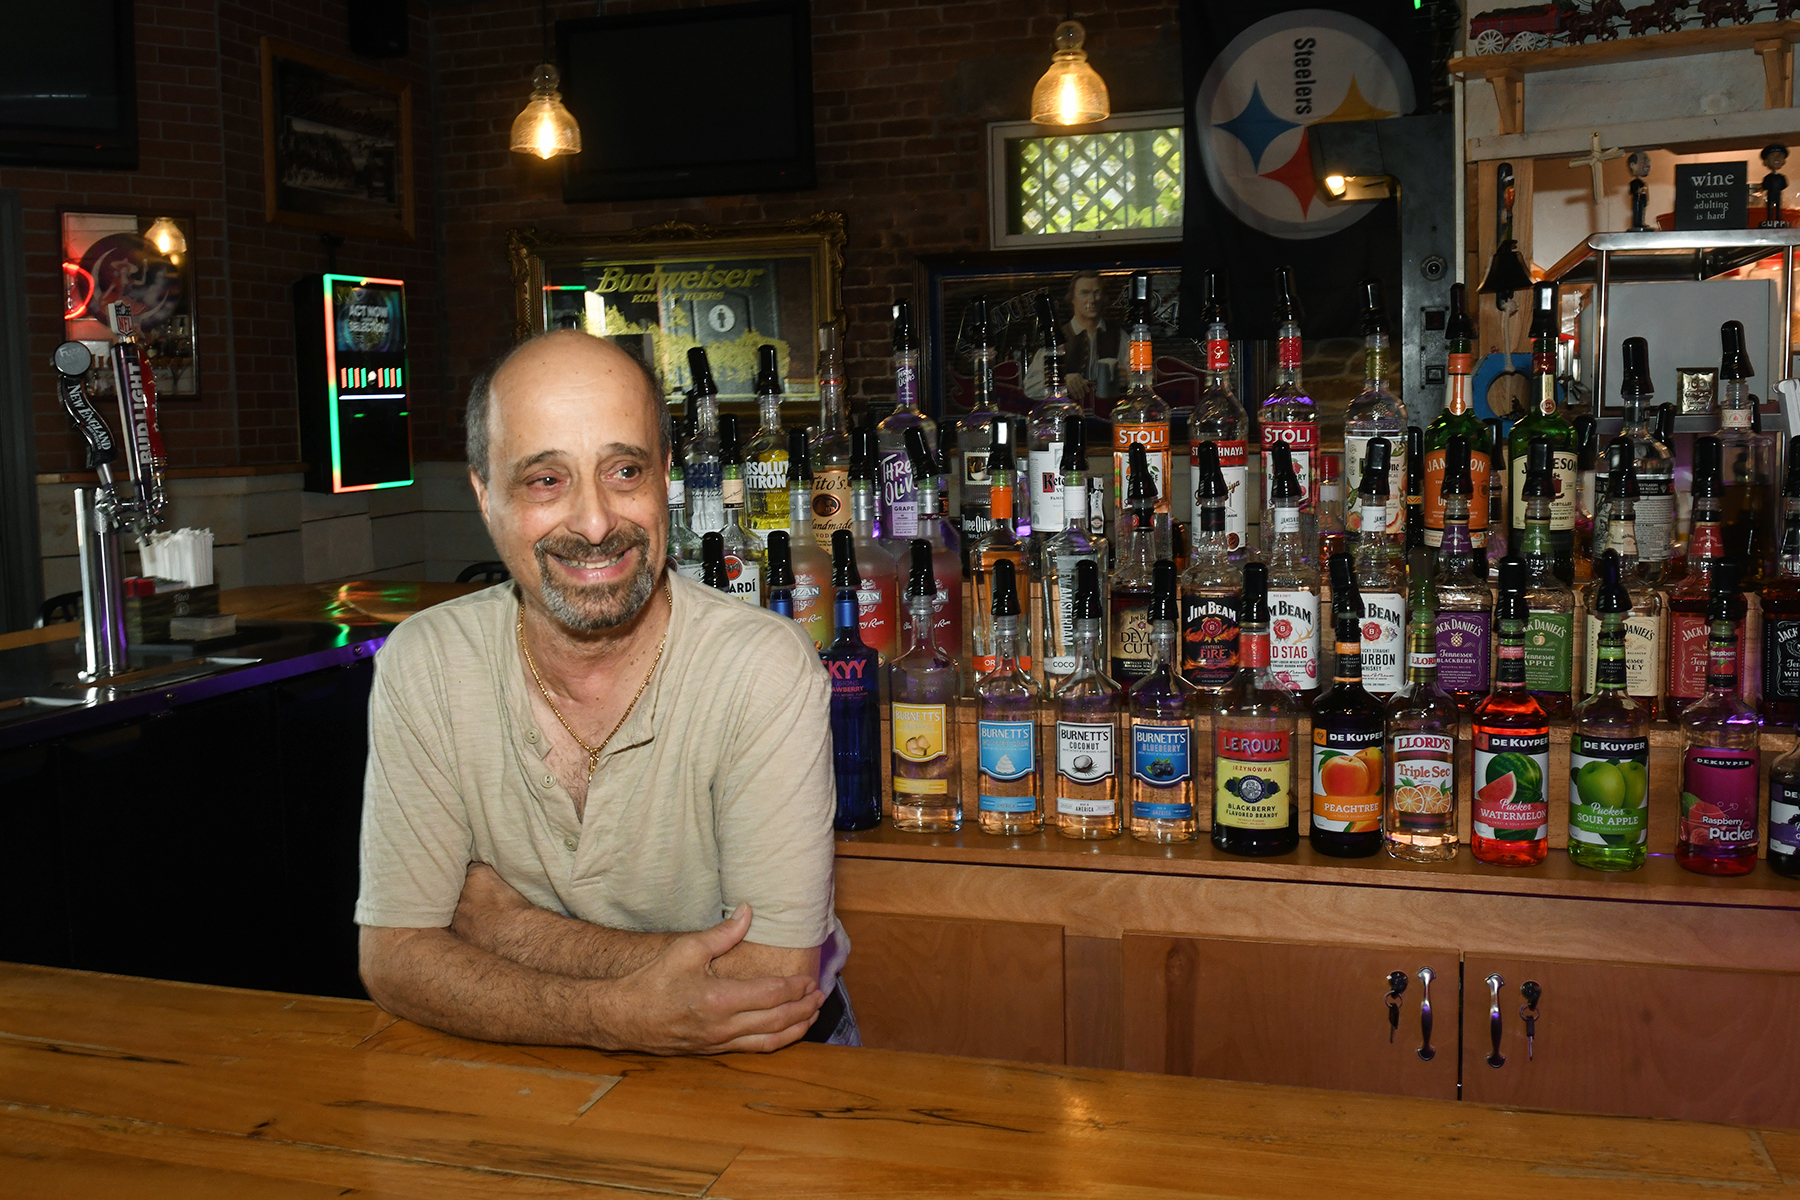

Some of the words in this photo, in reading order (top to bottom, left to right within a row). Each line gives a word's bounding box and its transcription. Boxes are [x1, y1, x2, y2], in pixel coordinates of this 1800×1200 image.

[1294, 37, 1317, 116] Steelers
[1691, 172, 1735, 187] wine
[1695, 190, 1729, 199] because
[1694, 200, 1729, 211] adulting
[1707, 210, 1726, 220] hard
[594, 264, 765, 293] Budweiser
[118, 316, 132, 333] NFL
[127, 362, 148, 420] LIGHT
[67, 383, 86, 408] NEW
[77, 407, 112, 451] ENGLAND
[1119, 430, 1164, 444] STOLI
[1264, 428, 1310, 444] STOLI
[135, 422, 153, 465] BUD
[1191, 446, 1244, 456] STHNAYA
[746, 461, 789, 476] BSOLUT
[728, 578, 756, 594] ARDÍ
[1060, 587, 1074, 646] AMSTERDAM
[1187, 604, 1207, 623] JIM
[1207, 601, 1237, 622] BEAM
[1279, 600, 1312, 625] BEAM
[1368, 603, 1400, 628] BEAM
[1436, 621, 1450, 634] ACK
[1451, 618, 1483, 637] DANIEL'S
[1535, 619, 1567, 638] DANIEL'S
[1682, 626, 1704, 642] JACK
[1777, 627, 1798, 643] JACK
[1200, 649, 1226, 659] FIRE
[1282, 646, 1308, 659] STAG
[832, 685, 864, 693] AWBERRY
[895, 710, 940, 722] BURNETT'S
[982, 727, 1029, 739] BURNETT'S
[1061, 729, 1109, 741] BURNETT'S
[1136, 731, 1187, 744] BURNETT'S
[1329, 733, 1345, 742] DE
[1346, 731, 1383, 742] KUYPER
[1069, 742, 1100, 750] COCONUT
[1142, 744, 1181, 752] BLUEBERRY
[1224, 736, 1281, 756] LEROUX
[1398, 737, 1451, 750] LLORD'S
[1491, 738, 1508, 746] DE
[1509, 737, 1548, 747] KUYPER
[1583, 741, 1598, 750] DE
[1600, 741, 1645, 751] KUYPER
[1696, 758, 1750, 766] DEKUYPER
[1397, 763, 1431, 779] Triple
[1431, 766, 1451, 777] Sec
[1784, 790, 1798, 799] DE
[1228, 803, 1276, 811] BLACKBERRY
[1324, 802, 1379, 813] PEACHTREE
[1499, 798, 1532, 811] Pucker
[1590, 802, 1624, 816] Pucker
[1226, 809, 1253, 818] FLAVORED
[1480, 808, 1546, 821] WATERMELON
[1577, 812, 1604, 825] SOUR
[1607, 816, 1639, 826] APPLE
[1702, 815, 1744, 826] Raspberry
